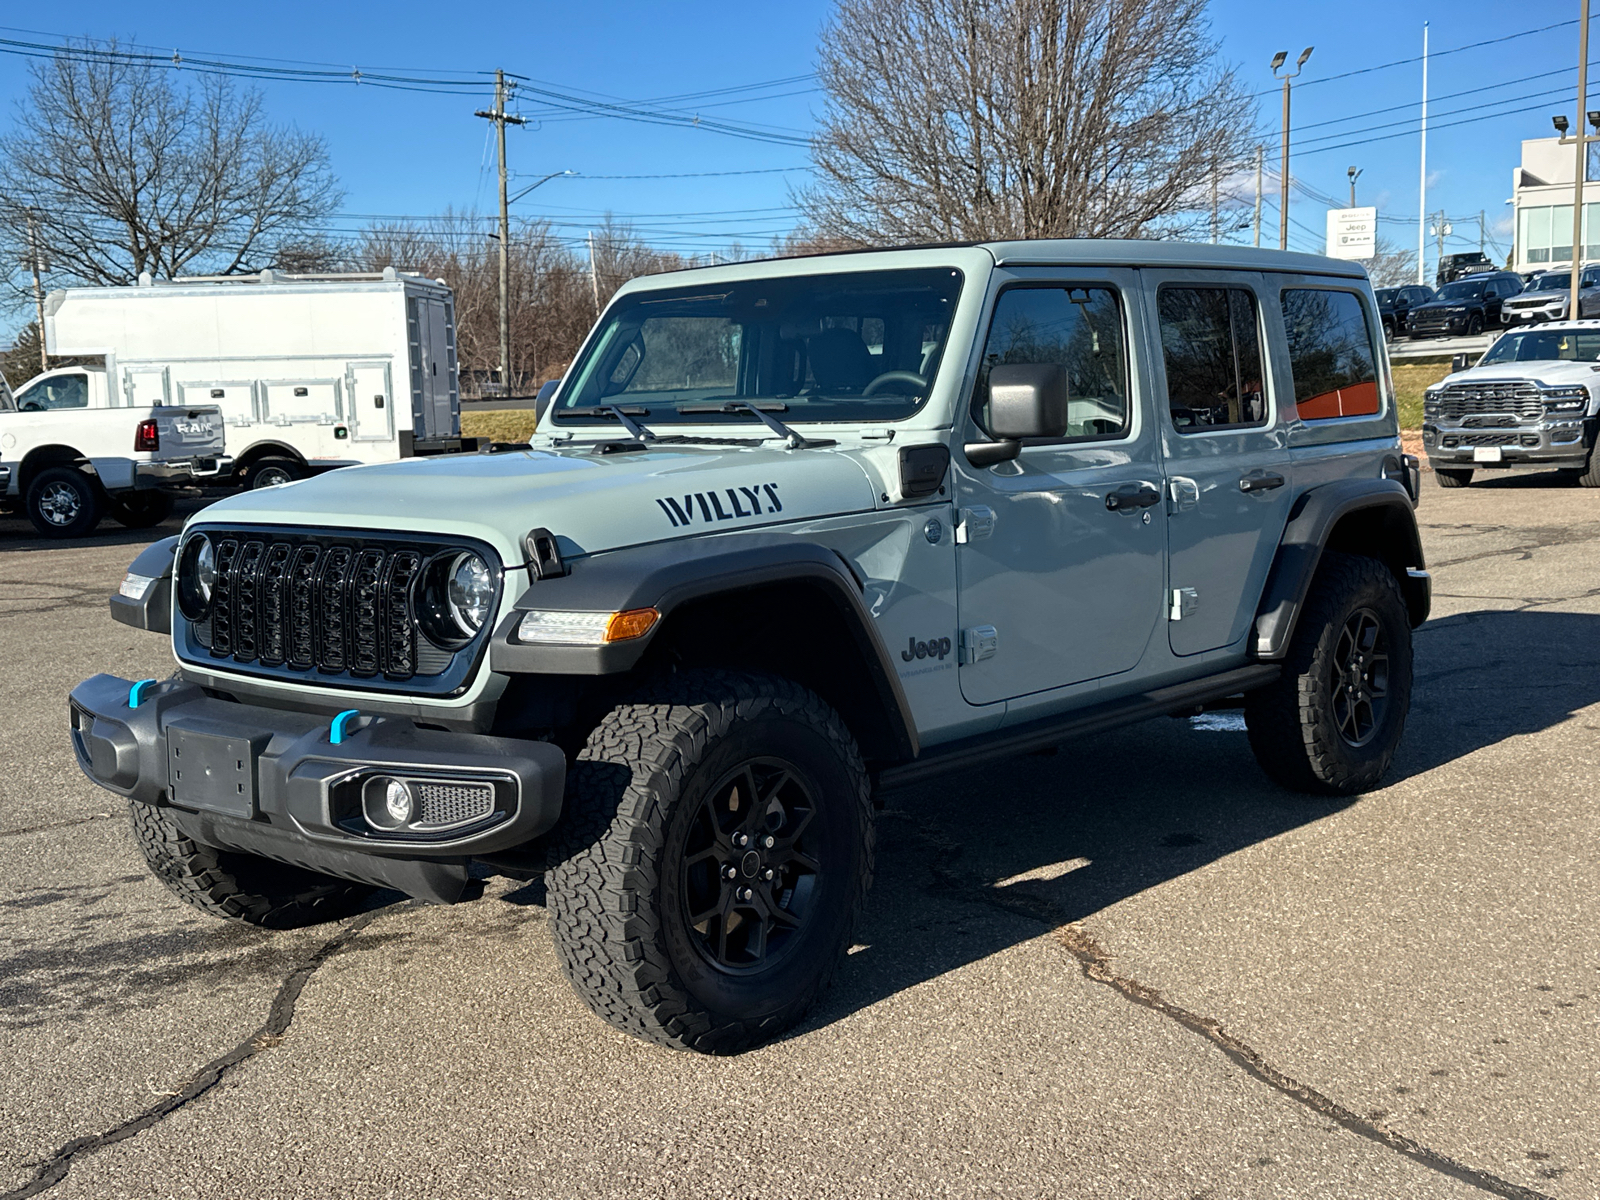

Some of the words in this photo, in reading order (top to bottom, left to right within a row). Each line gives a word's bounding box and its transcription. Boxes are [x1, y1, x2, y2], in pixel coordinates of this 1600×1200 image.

[175, 422, 212, 433] RAM
[655, 482, 783, 527] WILLYS
[901, 636, 952, 662] Jeep
